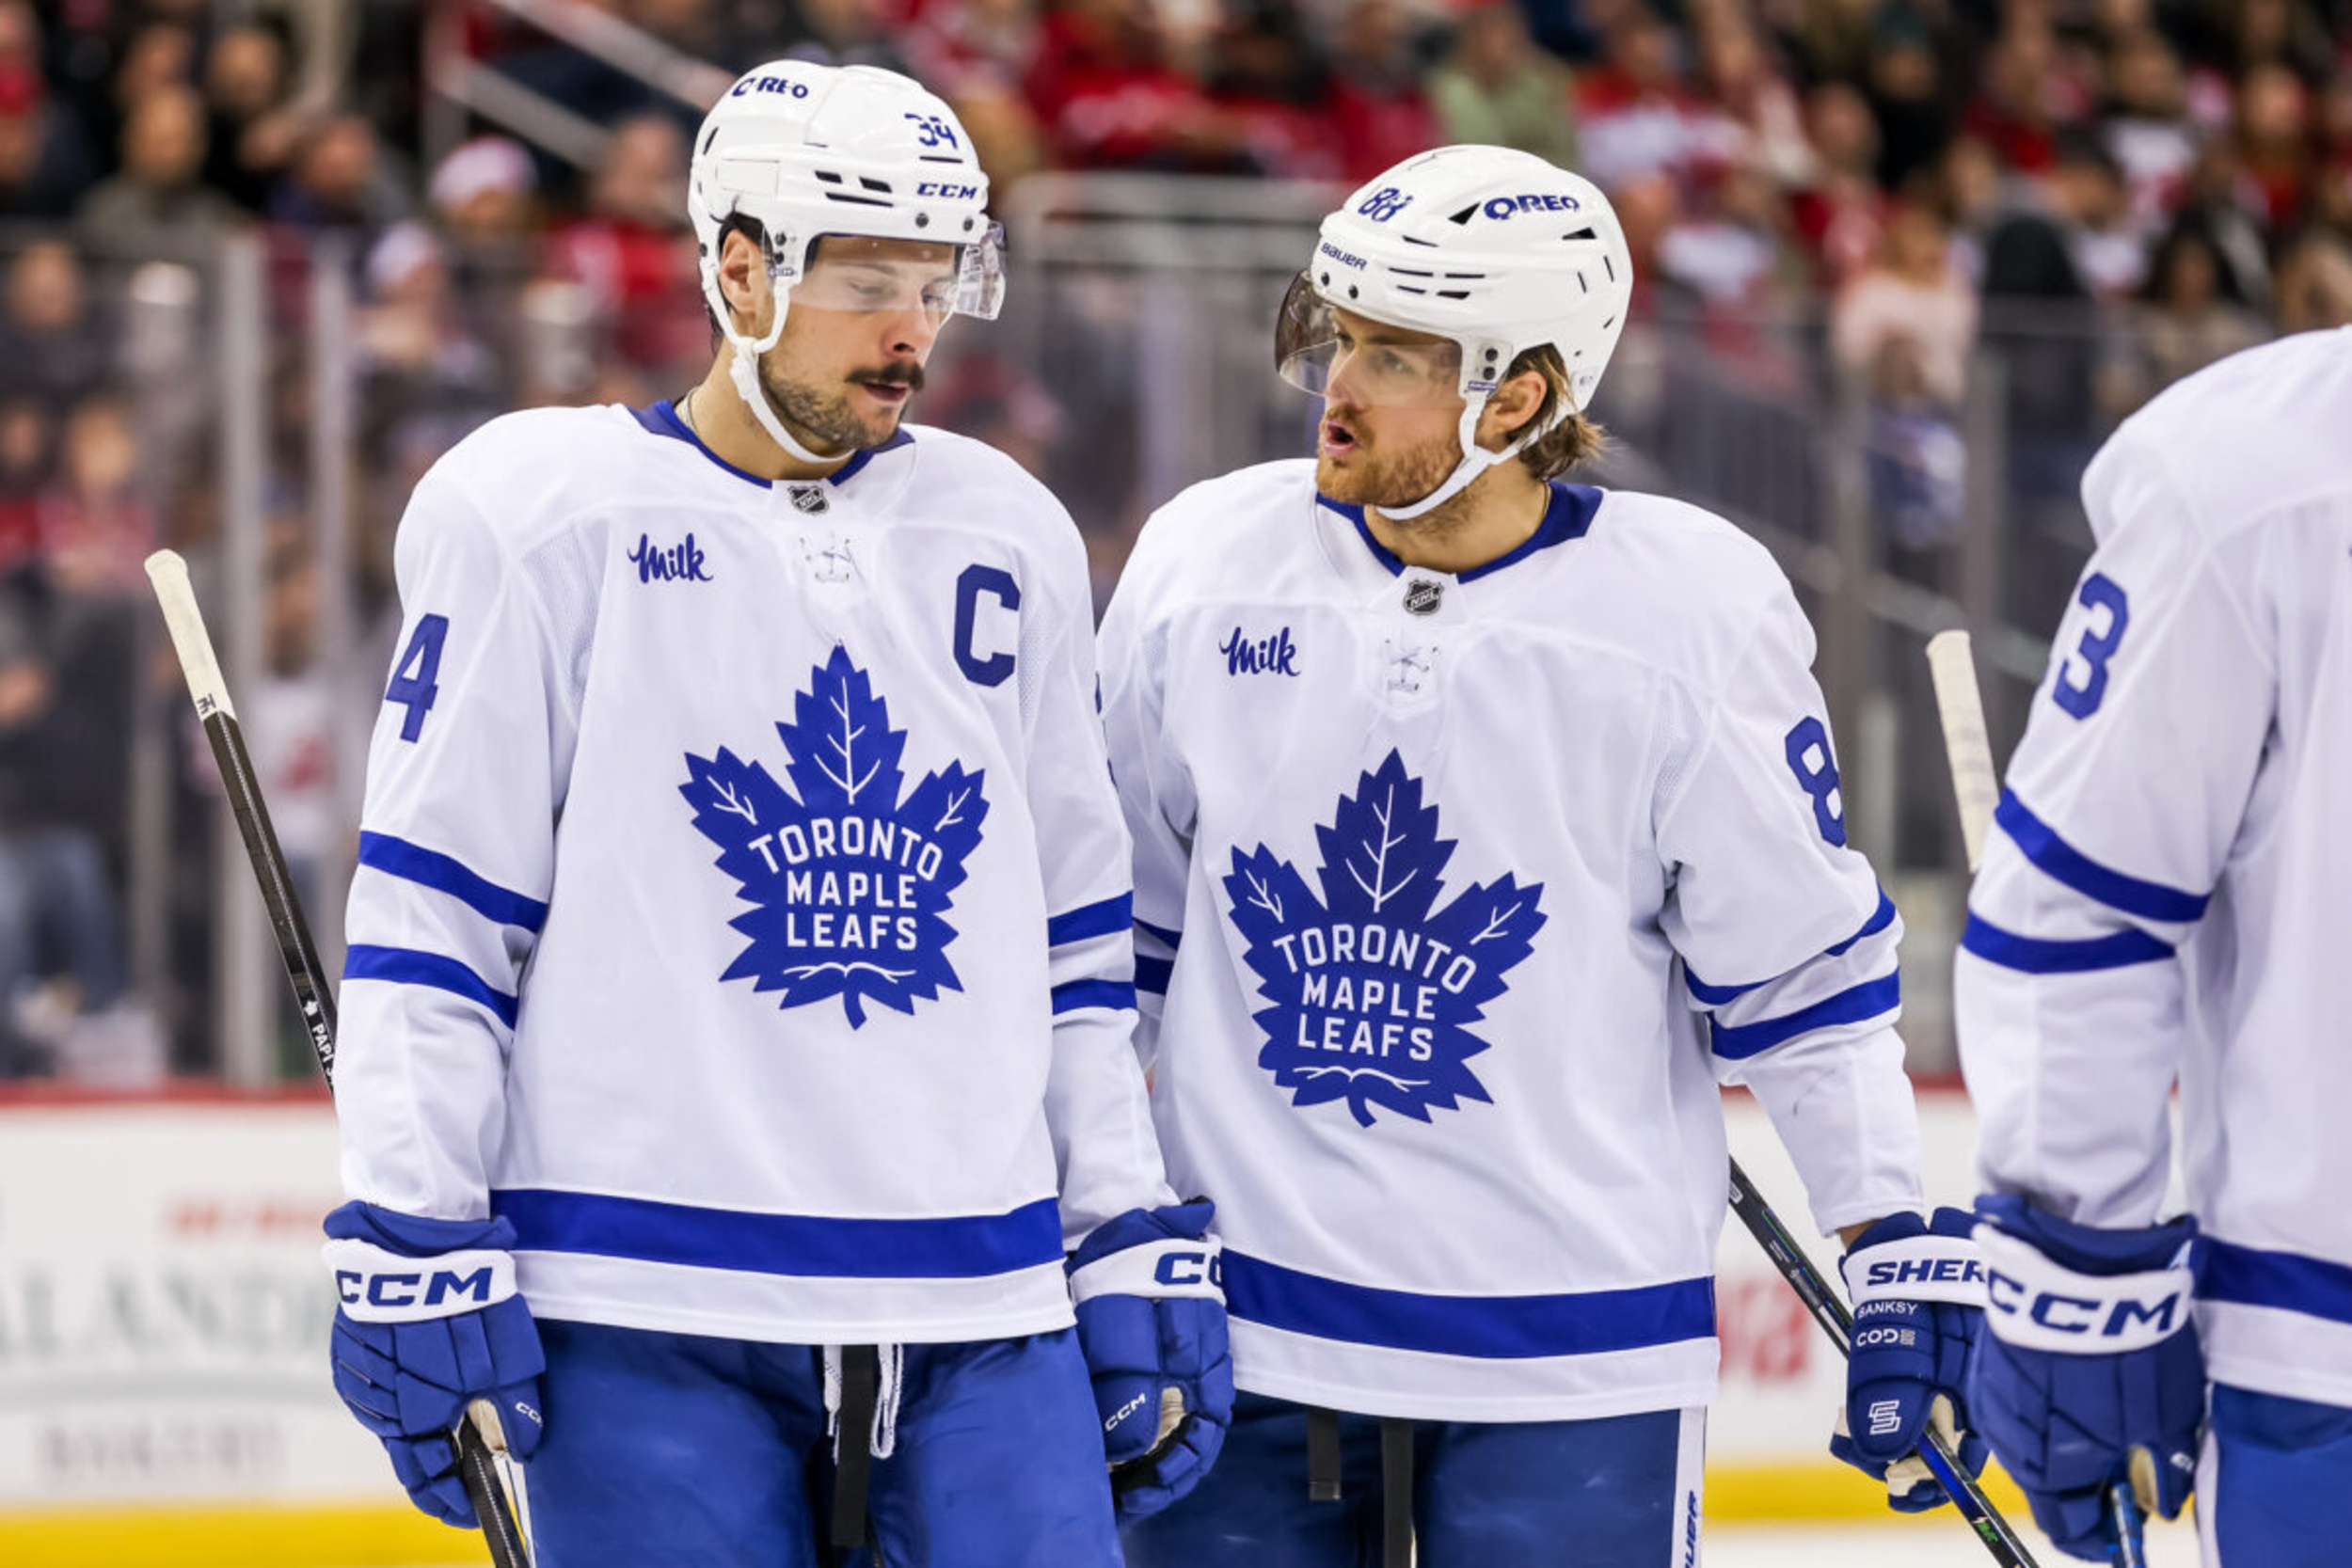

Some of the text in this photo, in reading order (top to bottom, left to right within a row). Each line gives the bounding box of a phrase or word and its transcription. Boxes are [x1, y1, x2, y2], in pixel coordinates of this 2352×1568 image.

[904, 113, 958, 150] 34
[916, 182, 977, 199] CCM
[1484, 194, 1581, 220] OREO
[1320, 242, 1367, 271] BAUER
[628, 533, 714, 583] Milk
[953, 563, 1021, 688] C
[2053, 572, 2128, 721] 3
[1219, 626, 1301, 677] Milk
[386, 612, 449, 743] 4
[1785, 716, 1847, 847] 8
[748, 816, 943, 881] TORONTO
[787, 870, 917, 909] MAPLE
[787, 913, 917, 951] LEAFS
[1272, 924, 1477, 994] TORONTO
[1301, 973, 1439, 1020] MAPLE
[311, 1022, 335, 1063] PAPI
[1297, 1013, 1434, 1062] LEAFS
[336, 1268, 493, 1307] CCM
[1857, 1301, 1918, 1320] BANKSY
[1988, 1267, 2180, 1337] CCM
[1104, 1392, 1146, 1432] CCM
